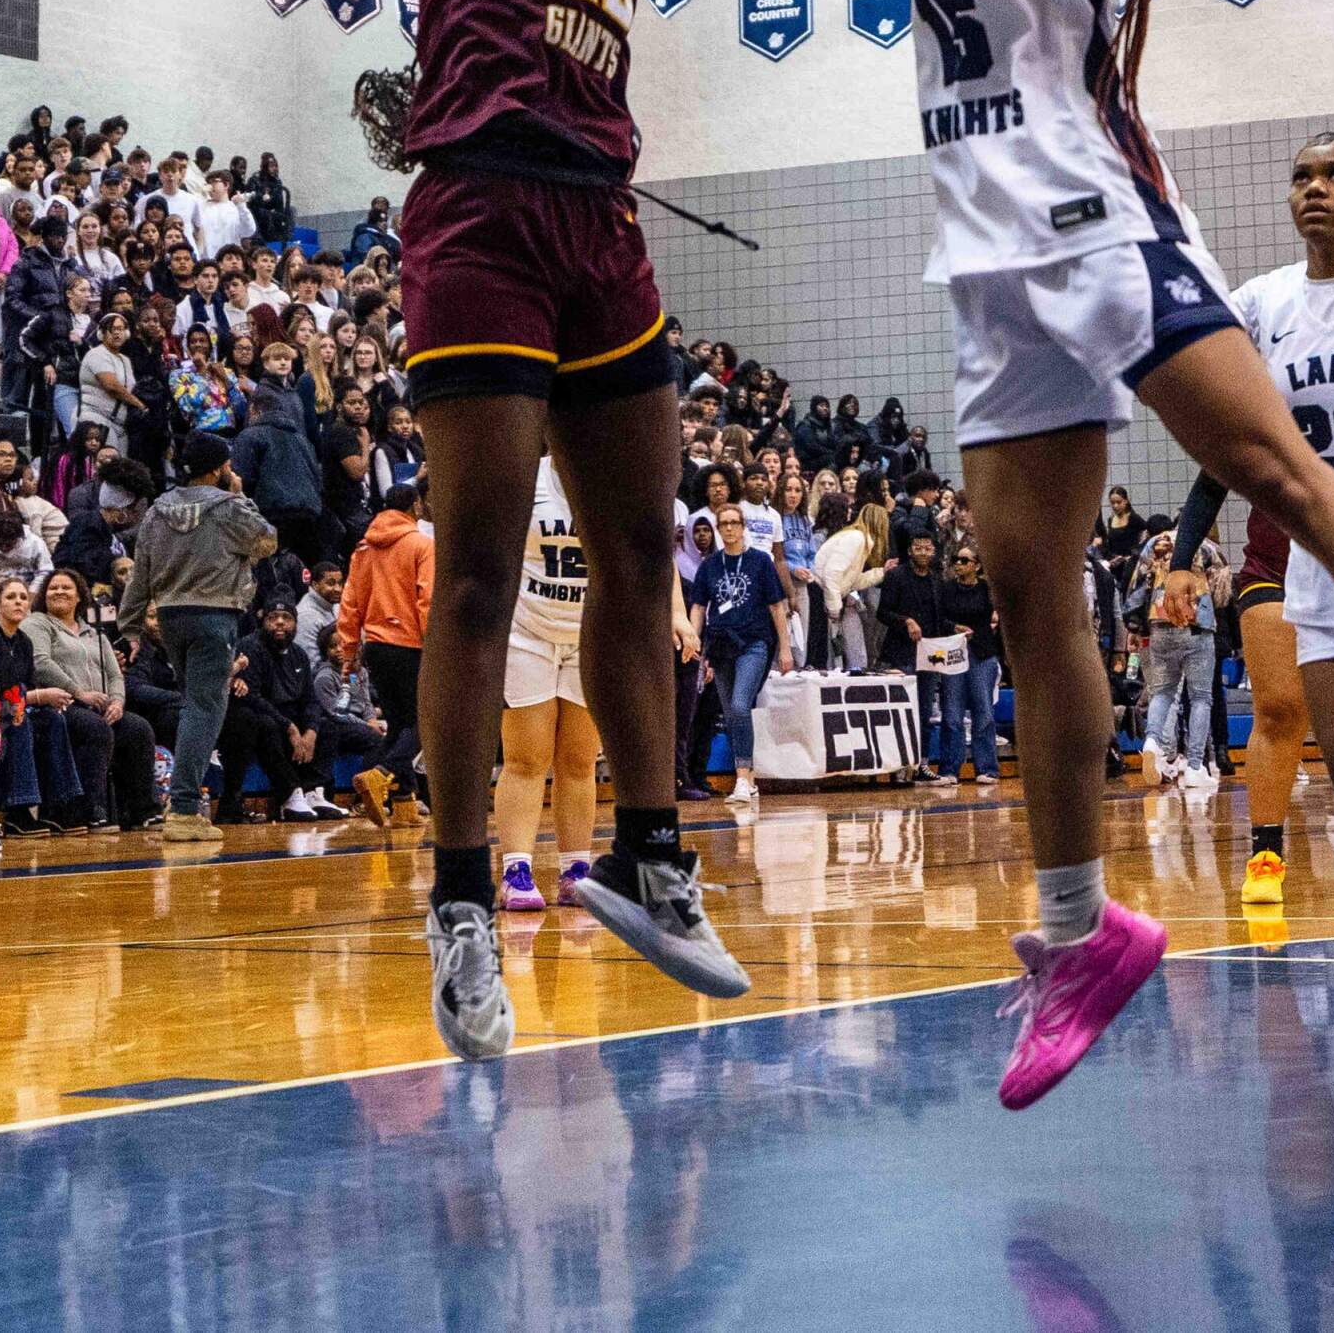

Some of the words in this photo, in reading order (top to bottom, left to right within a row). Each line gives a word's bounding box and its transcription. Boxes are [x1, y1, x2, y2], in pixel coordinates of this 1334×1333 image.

[748, 7, 801, 23] COUNTRY
[544, 5, 622, 80] GIANTS
[540, 544, 587, 578] 12
